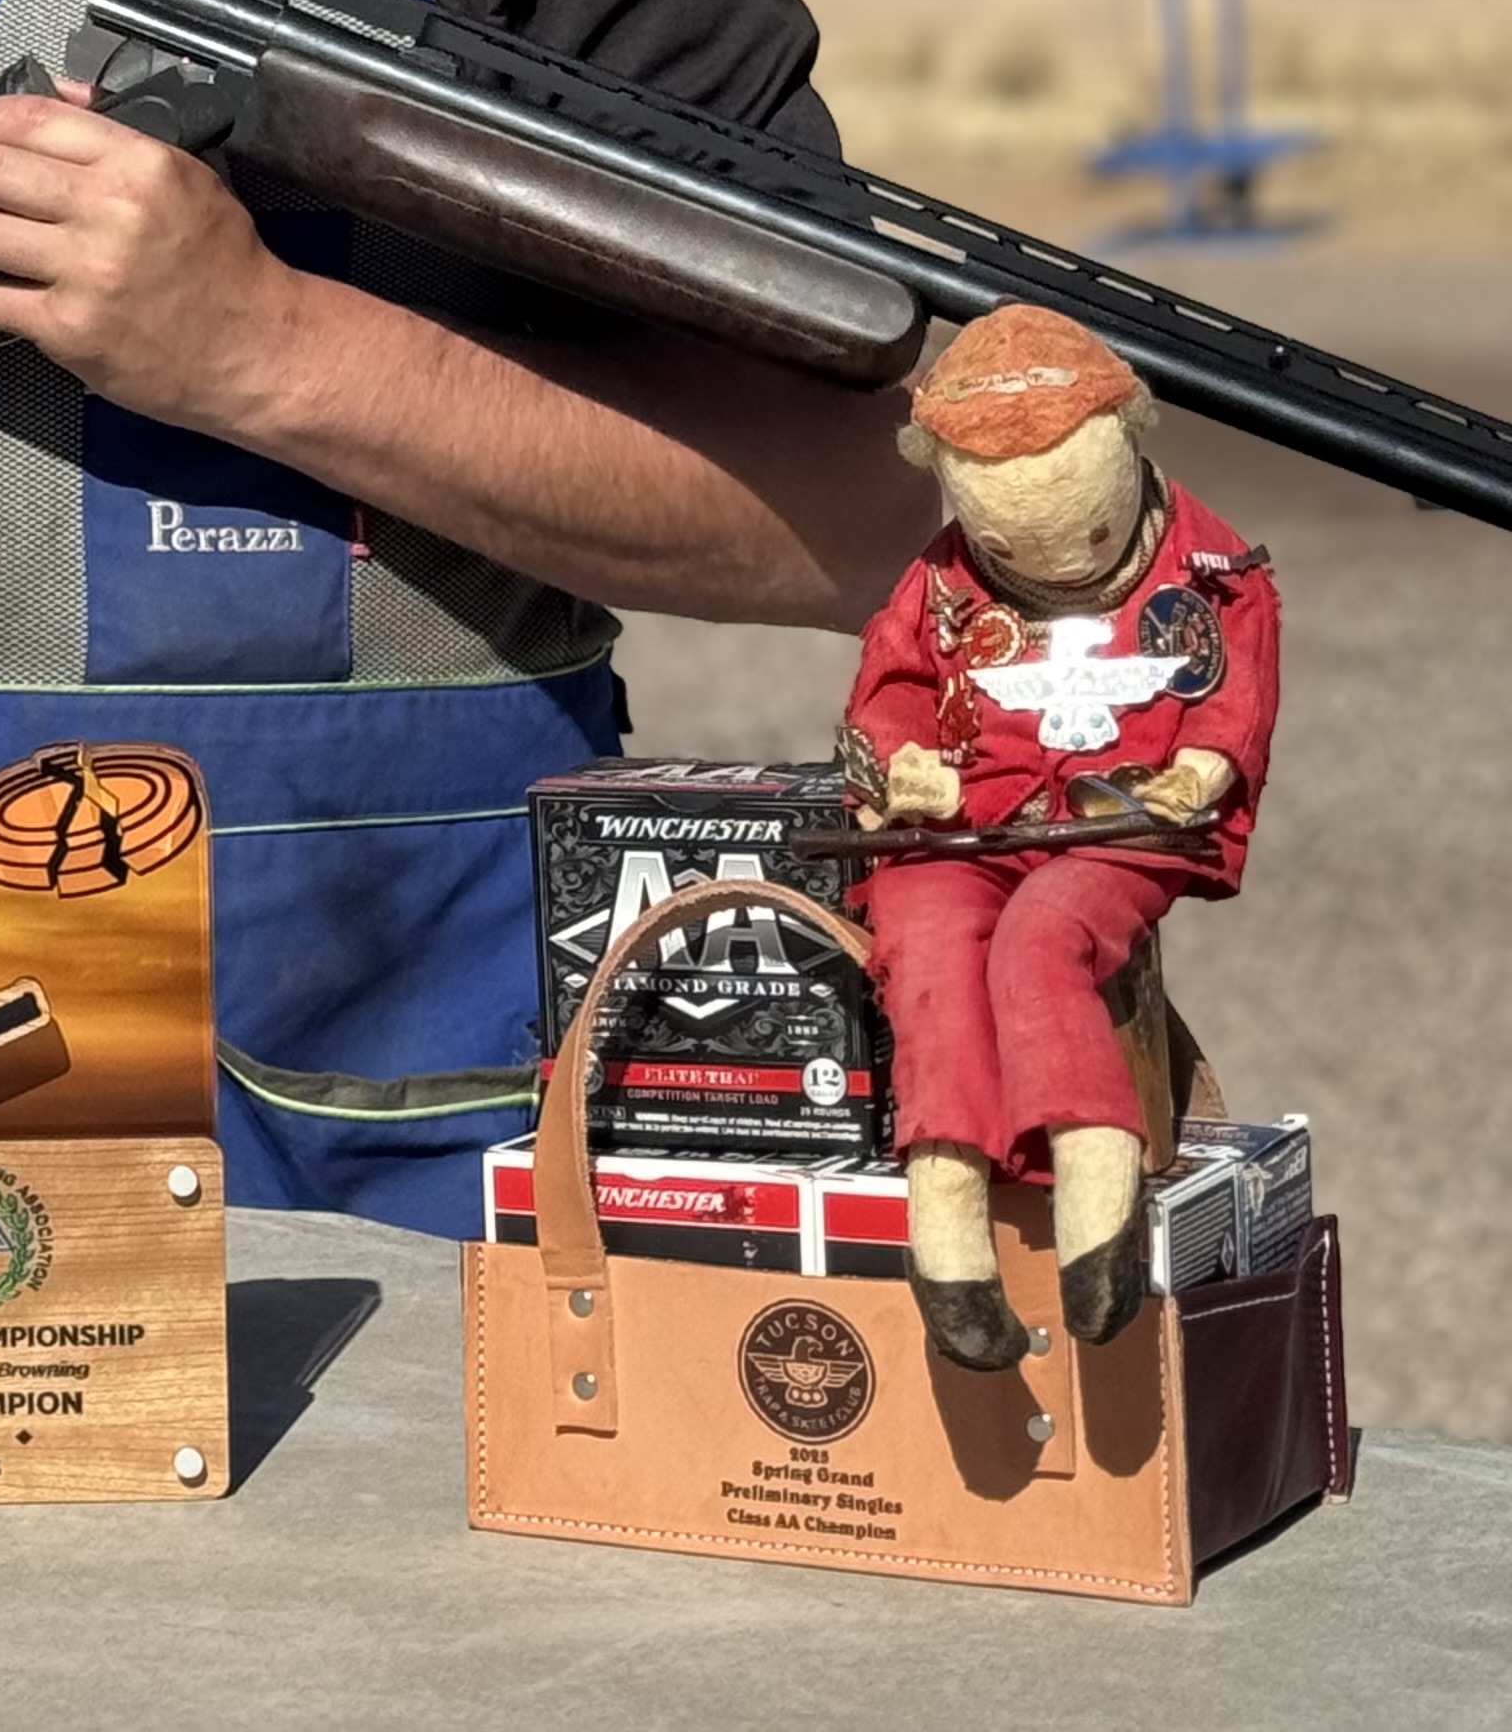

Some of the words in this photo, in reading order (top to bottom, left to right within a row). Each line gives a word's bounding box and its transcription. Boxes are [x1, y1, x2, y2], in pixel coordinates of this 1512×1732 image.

[146, 500, 304, 552] Perazzi
[595, 814, 784, 842] WINCHESTER
[612, 977, 709, 995] IAMOND
[717, 979, 801, 997] GRADE
[644, 1067, 702, 1084] ELITE
[807, 1067, 841, 1088] 12
[627, 1088, 701, 1102] COMPETITION
[704, 1092, 746, 1106] TARGET
[749, 1094, 780, 1105] LOAD
[596, 1184, 727, 1213] INCHESTER
[15, 1185, 54, 1292] ASSOCIATION
[755, 1312, 855, 1357] TUCSON
[835, 1386, 862, 1422] CLUB
[789, 1447, 830, 1464] 2025
[752, 1460, 813, 1485] Spring
[816, 1467, 875, 1488] Grand
[721, 1481, 832, 1511] Preliminary
[836, 1493, 903, 1516] Singles
[727, 1508, 771, 1528] Class
[774, 1513, 801, 1531] AA
[804, 1516, 897, 1541] Champion
